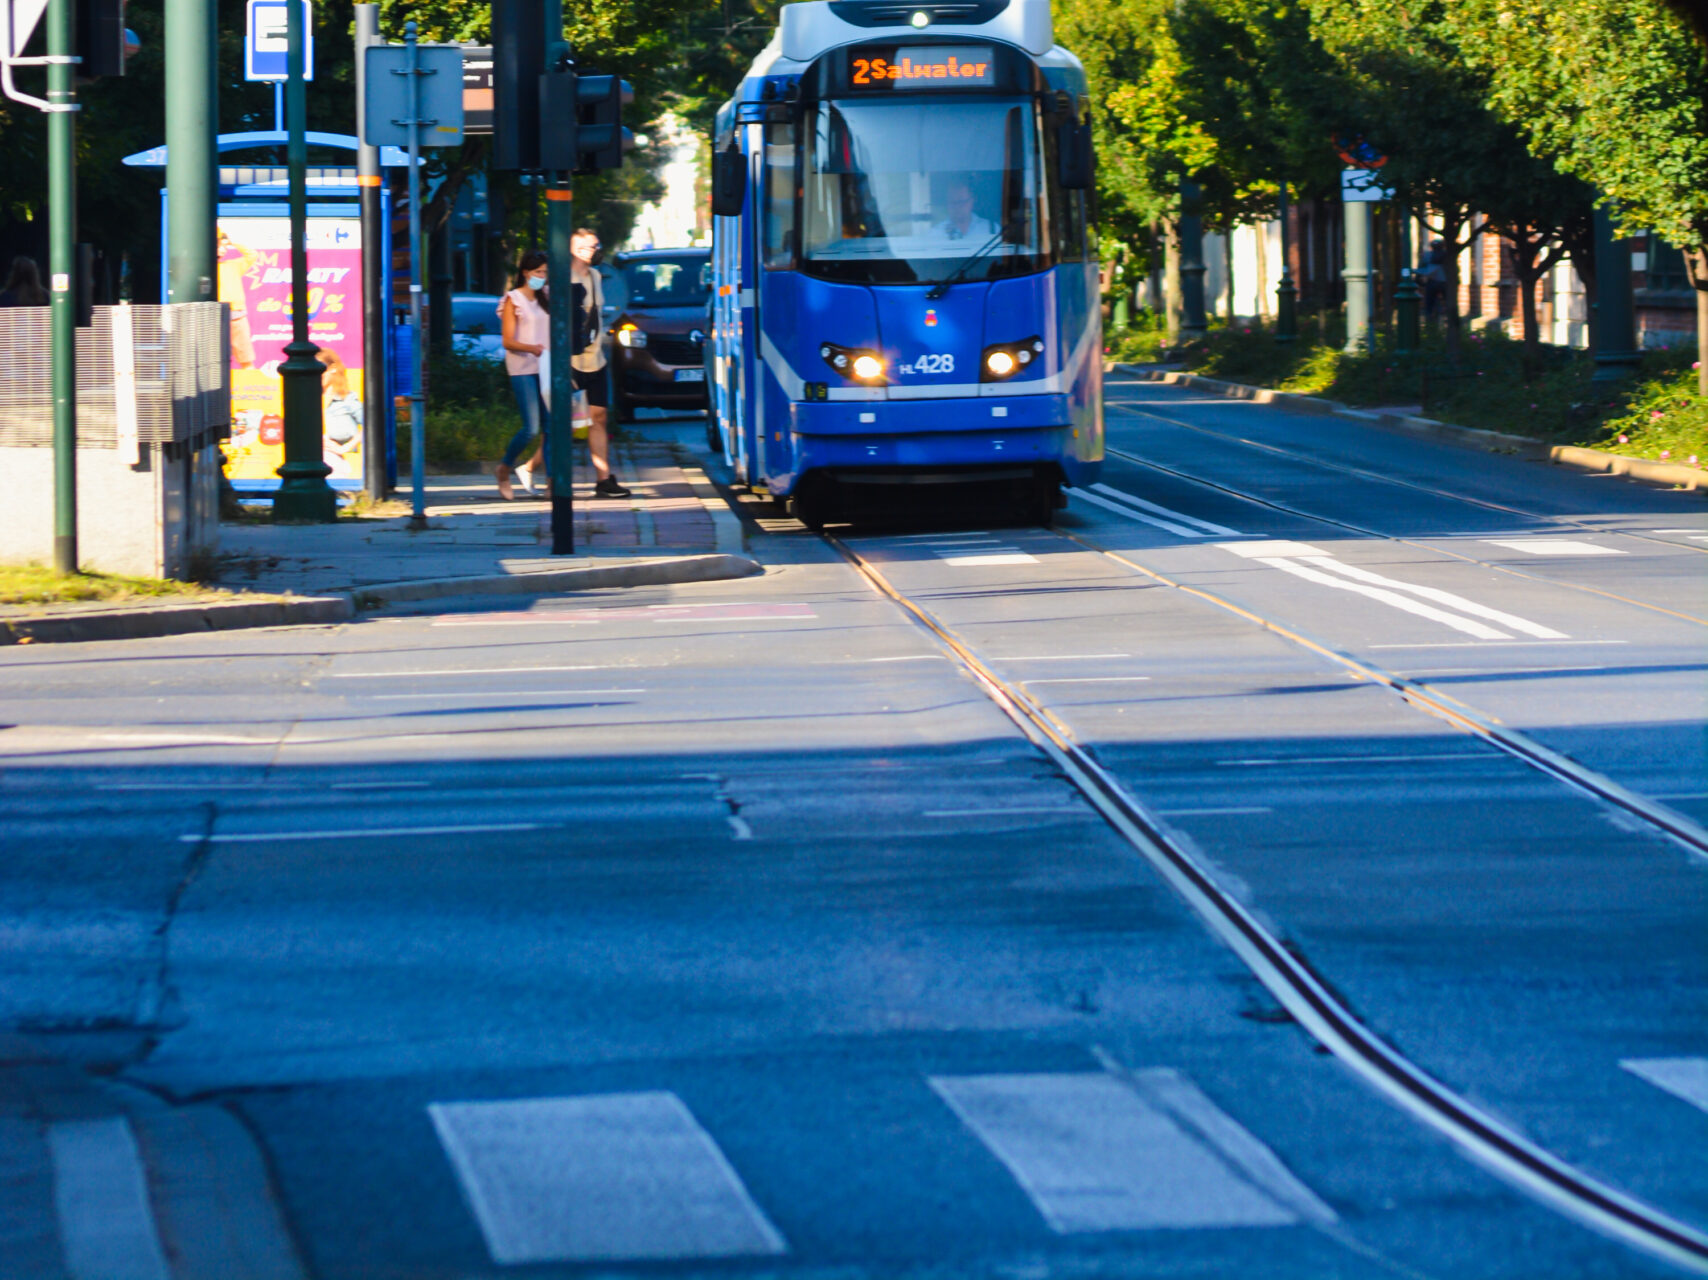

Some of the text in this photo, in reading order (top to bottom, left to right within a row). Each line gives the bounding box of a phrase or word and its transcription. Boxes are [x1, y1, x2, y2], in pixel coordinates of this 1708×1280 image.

[853, 56, 988, 84] 2 Salwator
[261, 267, 351, 284] RAATY
